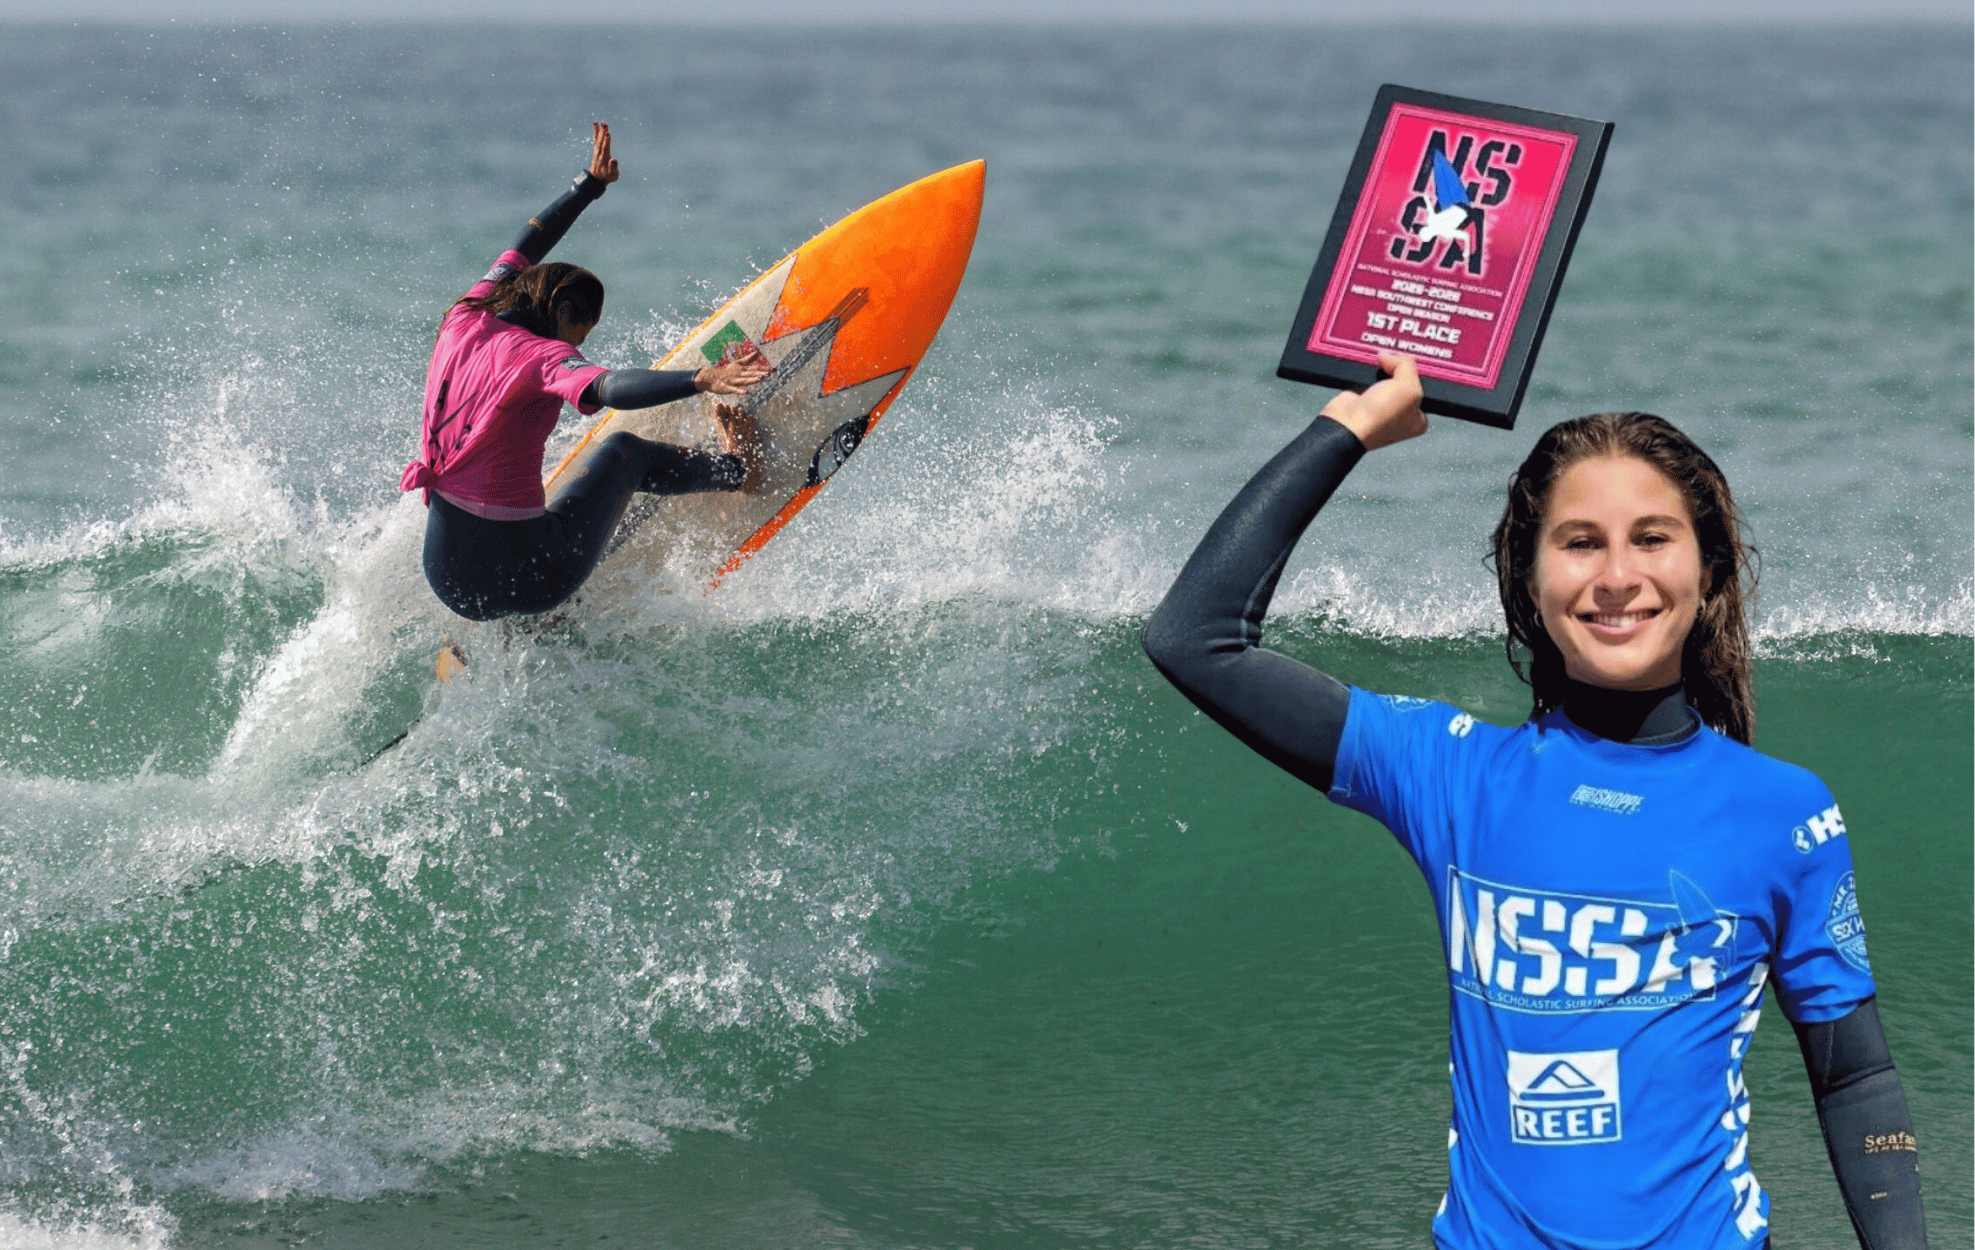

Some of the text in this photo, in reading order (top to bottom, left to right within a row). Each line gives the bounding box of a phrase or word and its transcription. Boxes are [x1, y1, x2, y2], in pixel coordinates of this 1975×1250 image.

[1387, 302, 1414, 316] OPEN
[1434, 301, 1495, 321] CONFERENCE
[1367, 311, 1462, 344] 1ST PLACE
[1361, 332, 1453, 358] OPEN WOMENS
[1450, 874, 1718, 997] NSSA
[1494, 991, 1562, 1011] SCHOLASTIC
[1516, 1106, 1613, 1138] REEF
